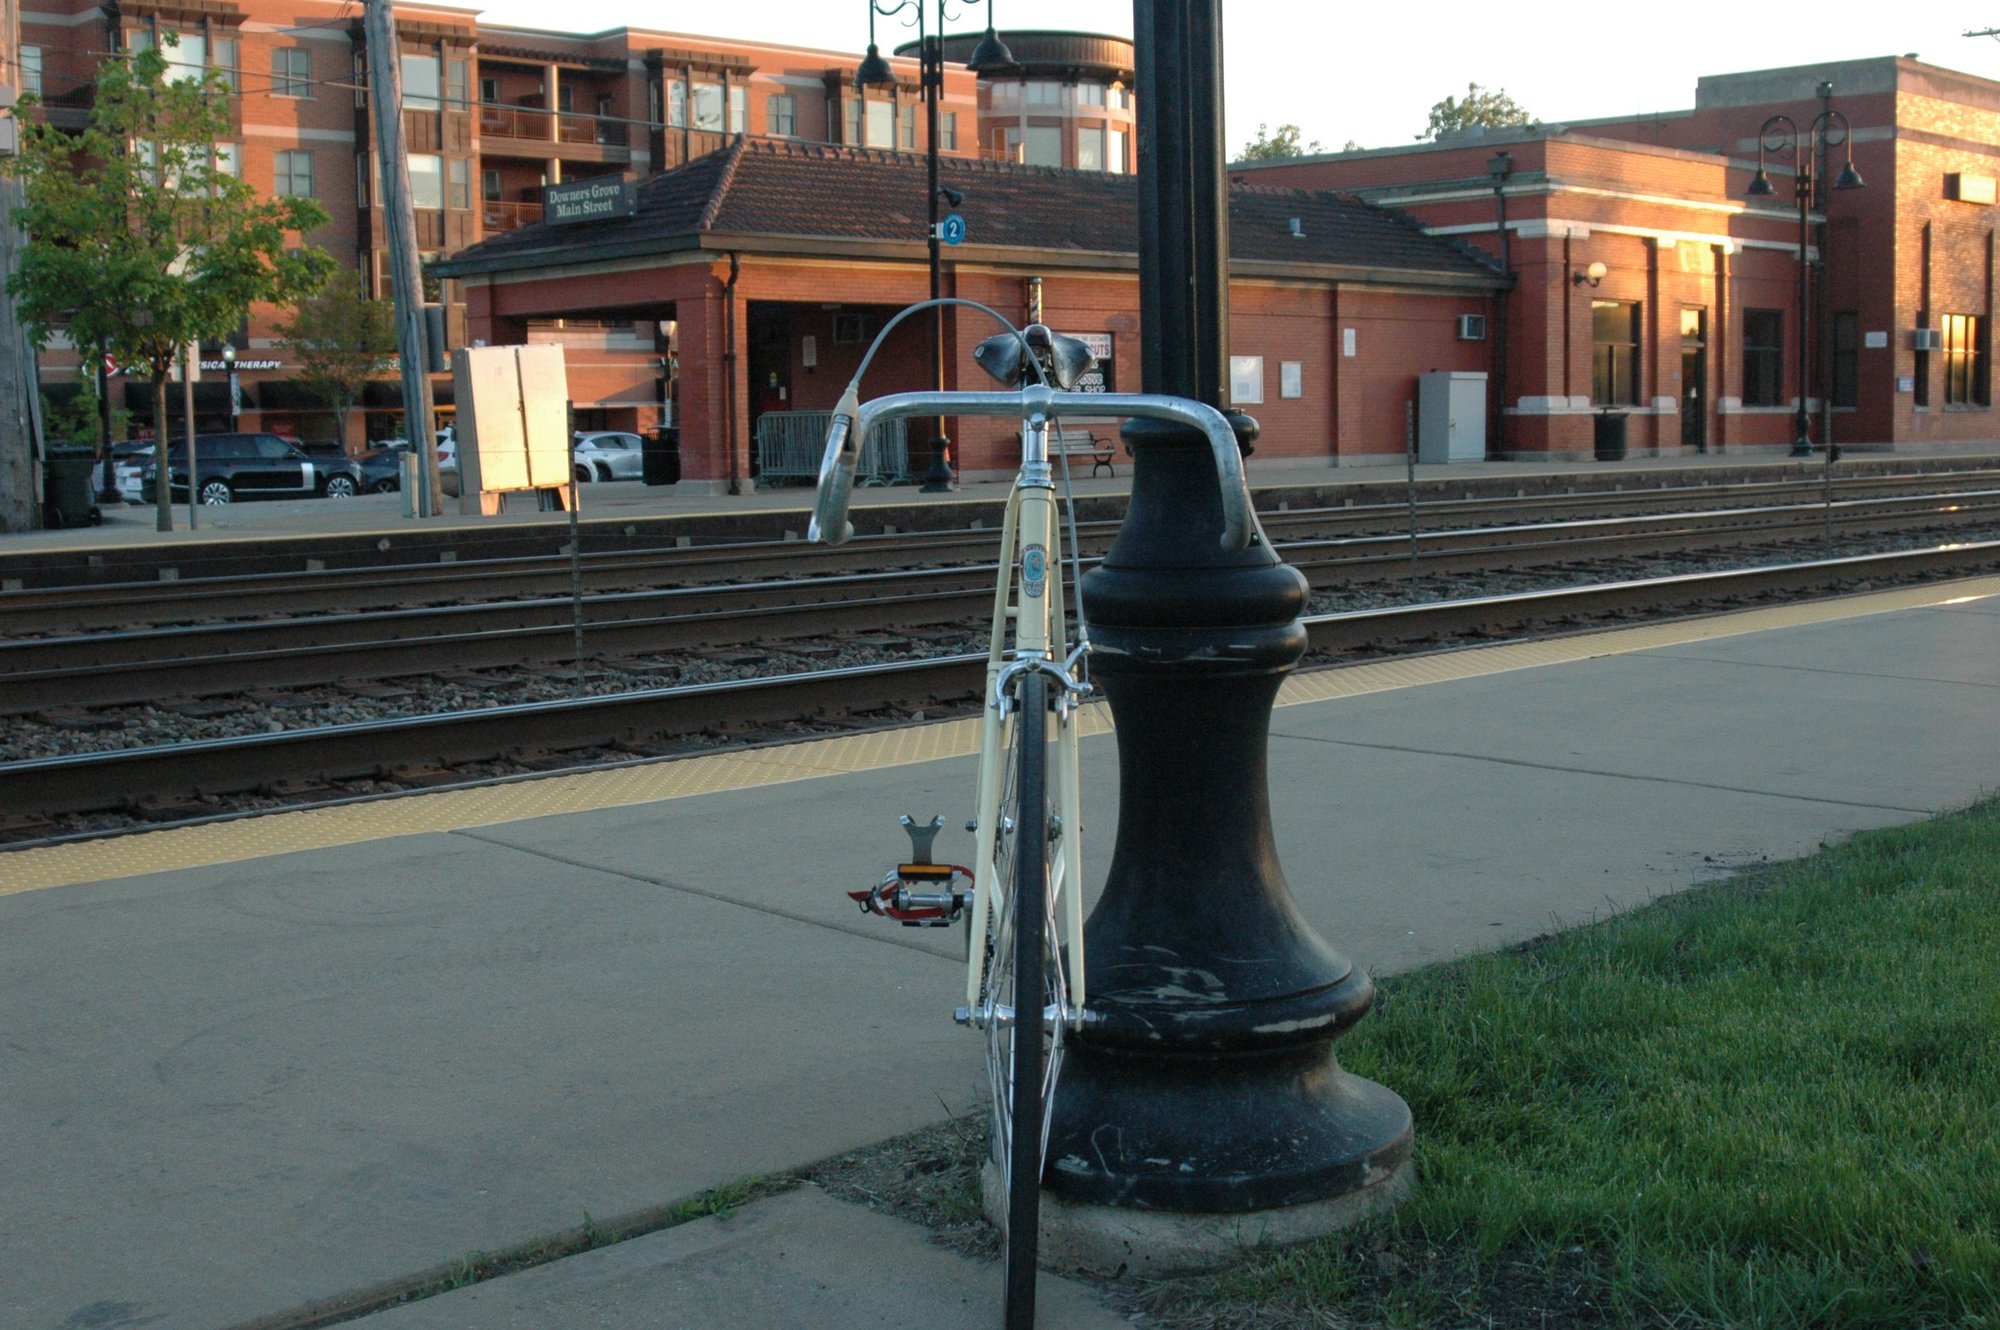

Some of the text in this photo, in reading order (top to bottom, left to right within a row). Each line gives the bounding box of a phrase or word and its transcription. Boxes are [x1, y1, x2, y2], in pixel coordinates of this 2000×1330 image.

[550, 184, 620, 204] Downers Grove
[556, 199, 613, 217] Main Street
[950, 221, 957, 238] 2
[233, 360, 282, 370] THERAPY
